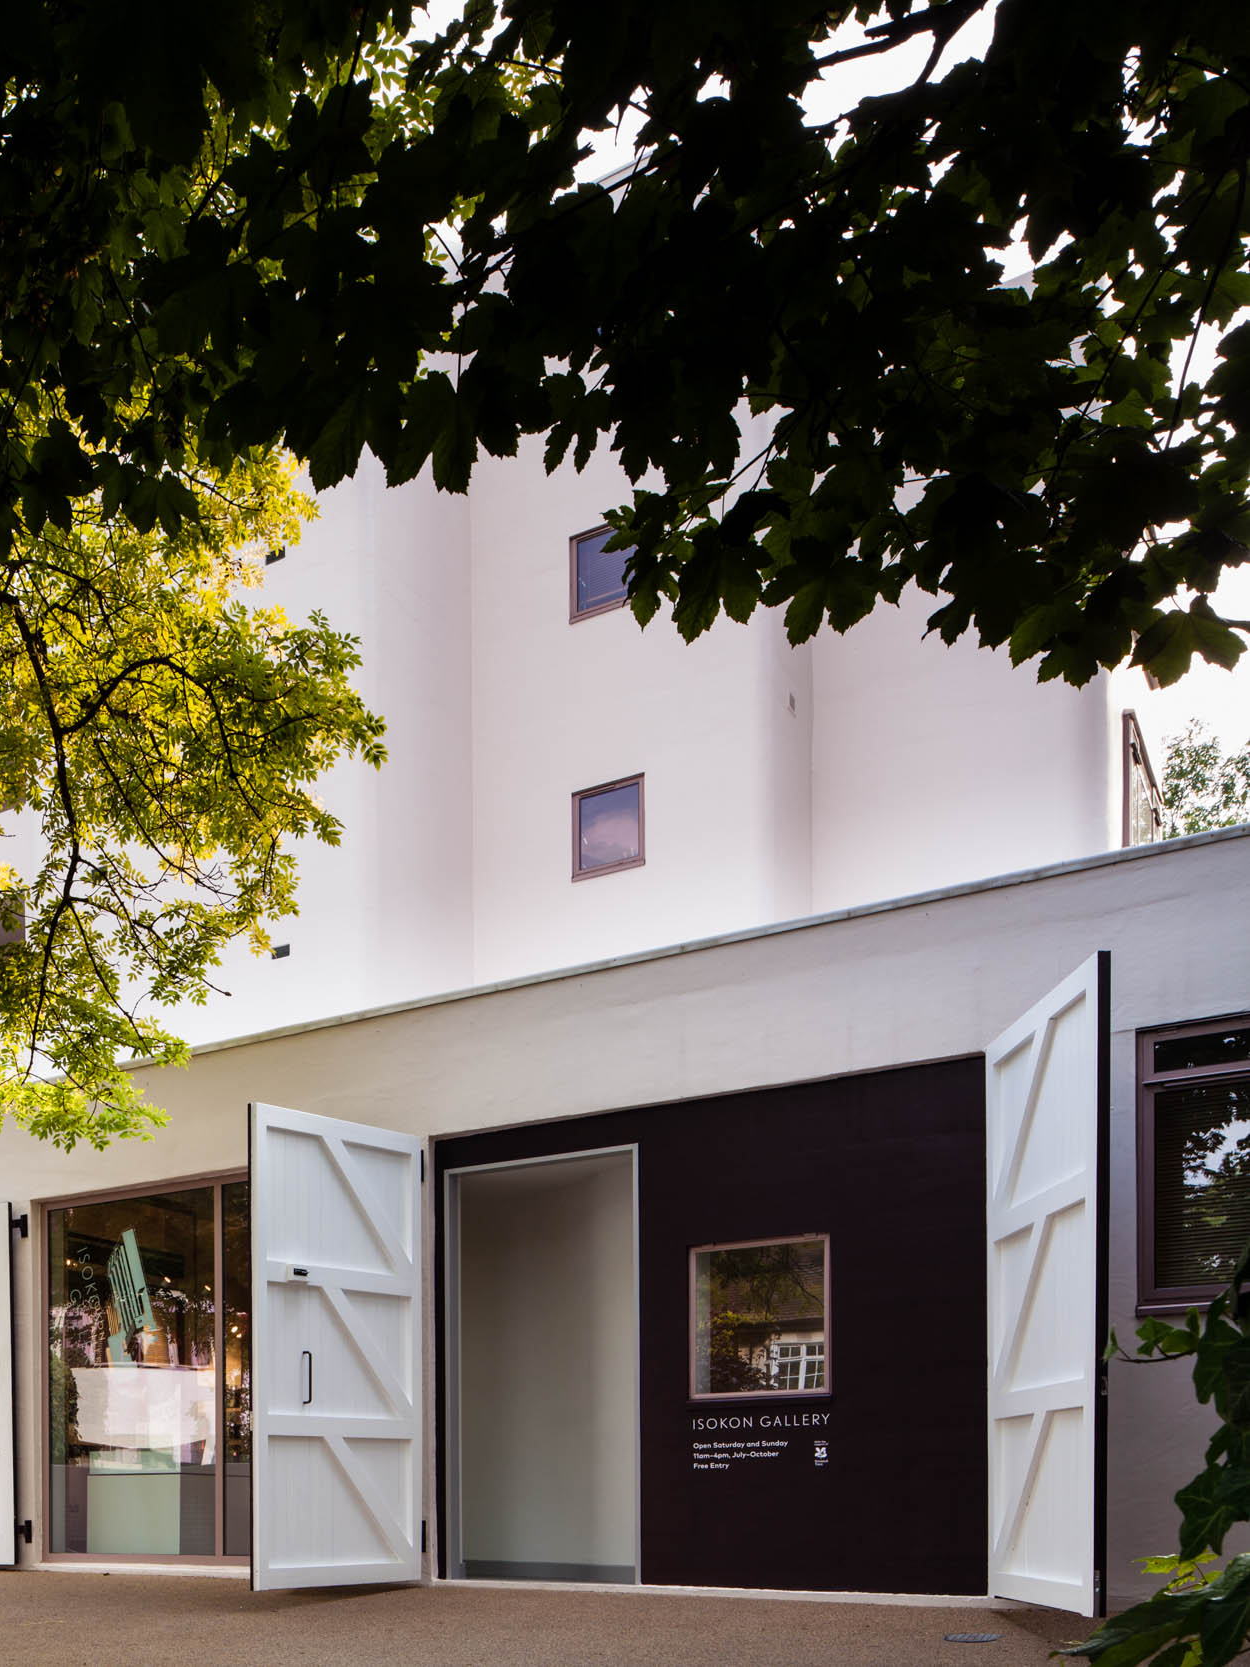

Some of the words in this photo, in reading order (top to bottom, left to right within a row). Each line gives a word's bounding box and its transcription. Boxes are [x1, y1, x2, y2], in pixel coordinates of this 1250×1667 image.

[692, 1416, 753, 1430] ISOKON
[759, 1413, 830, 1428] GALLERY
[761, 1440, 789, 1448] Sunday
[710, 1462, 730, 1470] Entry
